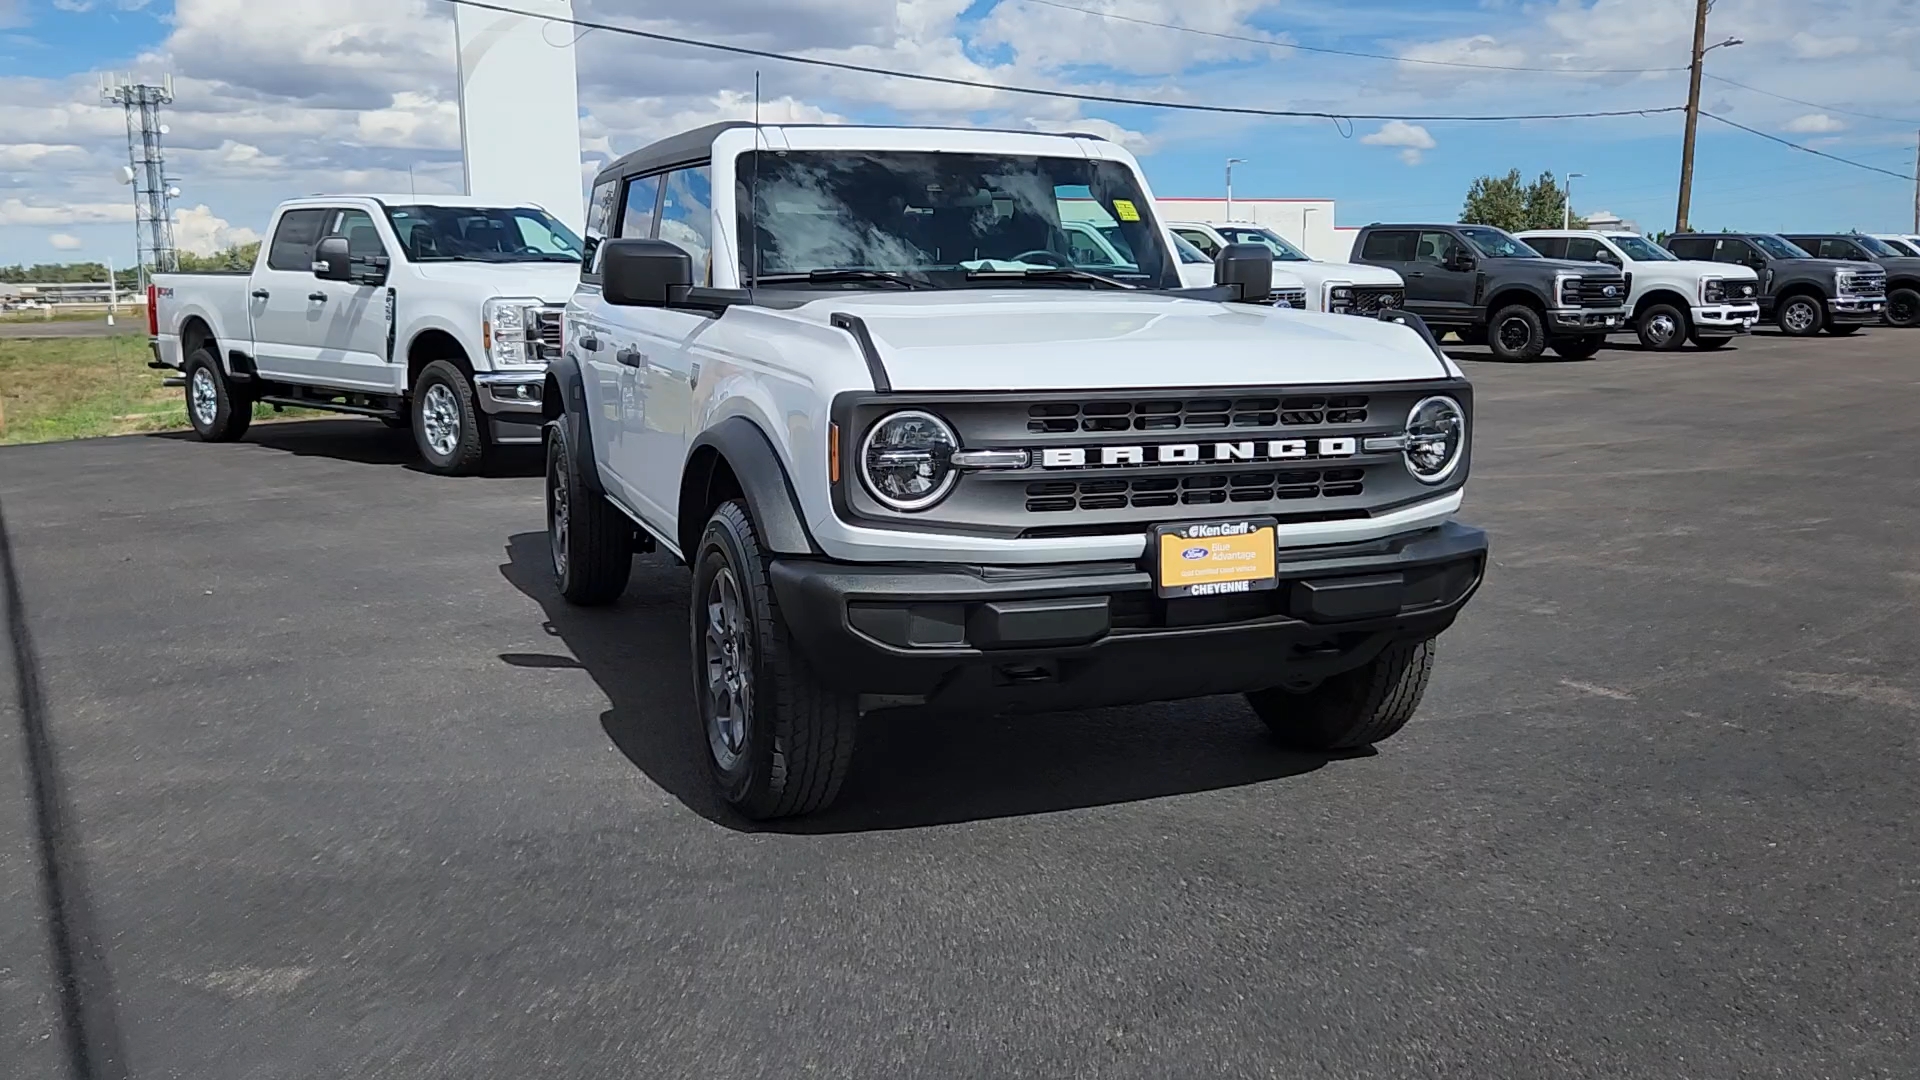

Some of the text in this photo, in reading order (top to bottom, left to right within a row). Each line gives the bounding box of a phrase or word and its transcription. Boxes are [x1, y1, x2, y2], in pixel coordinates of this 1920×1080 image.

[1042, 437, 1356, 467] BRONCO
[1199, 522, 1249, 537] Ken Garff
[1212, 543, 1231, 551] Blue
[1183, 548, 1207, 559] Ford
[1211, 550, 1257, 561] Advantage
[1191, 581, 1250, 595] CHEYENNE
